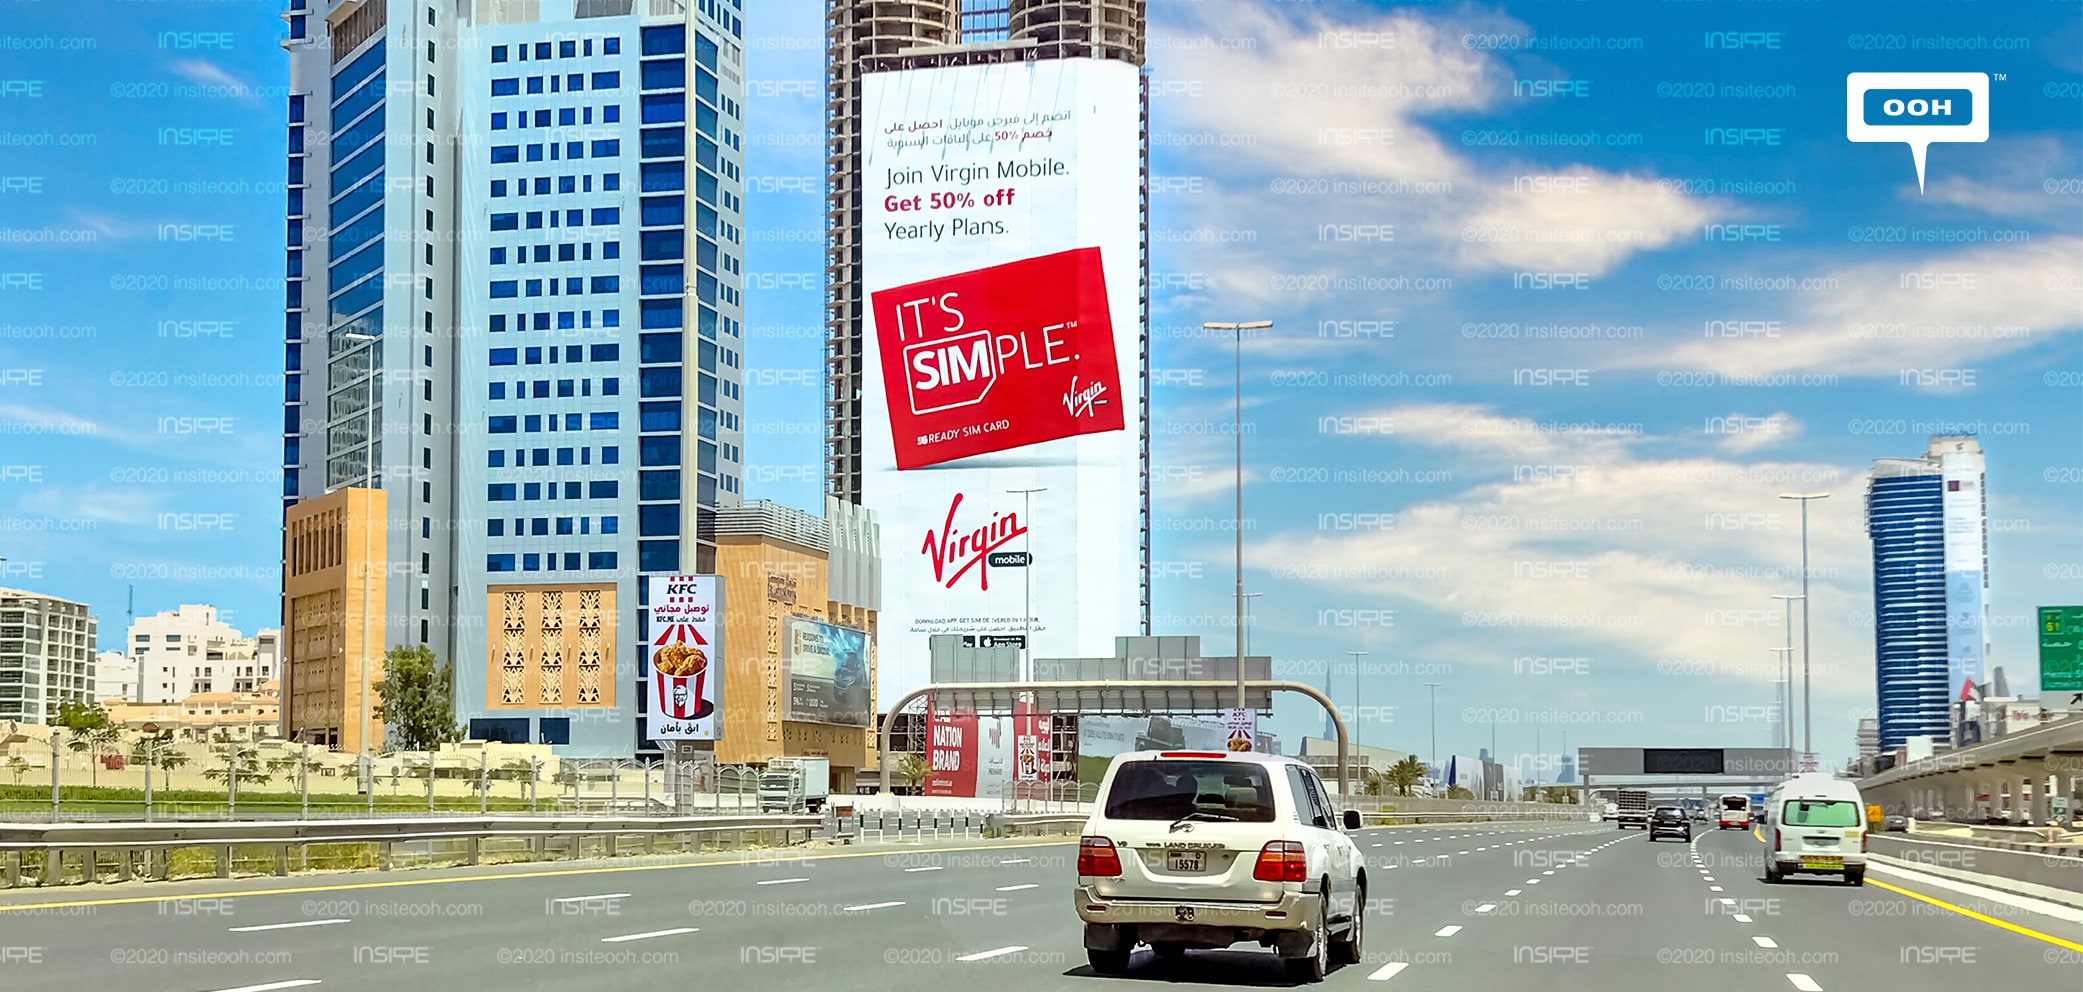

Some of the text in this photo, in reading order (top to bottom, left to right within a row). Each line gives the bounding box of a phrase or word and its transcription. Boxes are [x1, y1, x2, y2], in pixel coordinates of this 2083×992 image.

[884, 122, 904, 135] على
[908, 119, 943, 133] احصل
[995, 130, 1019, 142] 50%
[885, 157, 1070, 189] Join Virgin Mobile.
[884, 188, 1016, 213] Get 50% off
[884, 217, 1009, 243] Yearly Plans.
[896, 292, 965, 341] IT'S
[1062, 375, 1107, 417] Virgin
[928, 428, 960, 444] READY
[962, 424, 982, 438] SIM
[983, 419, 1010, 434] CARD
[921, 492, 1028, 591] Virgin
[994, 553, 1026, 564] mobile
[666, 584, 697, 595] KFC
[653, 604, 710, 615] توصيل مجاني
[660, 721, 681, 735] بأمان
[933, 725, 962, 748] NATION
[932, 749, 960, 772] BRAND
[1175, 859, 1199, 871] 15578
